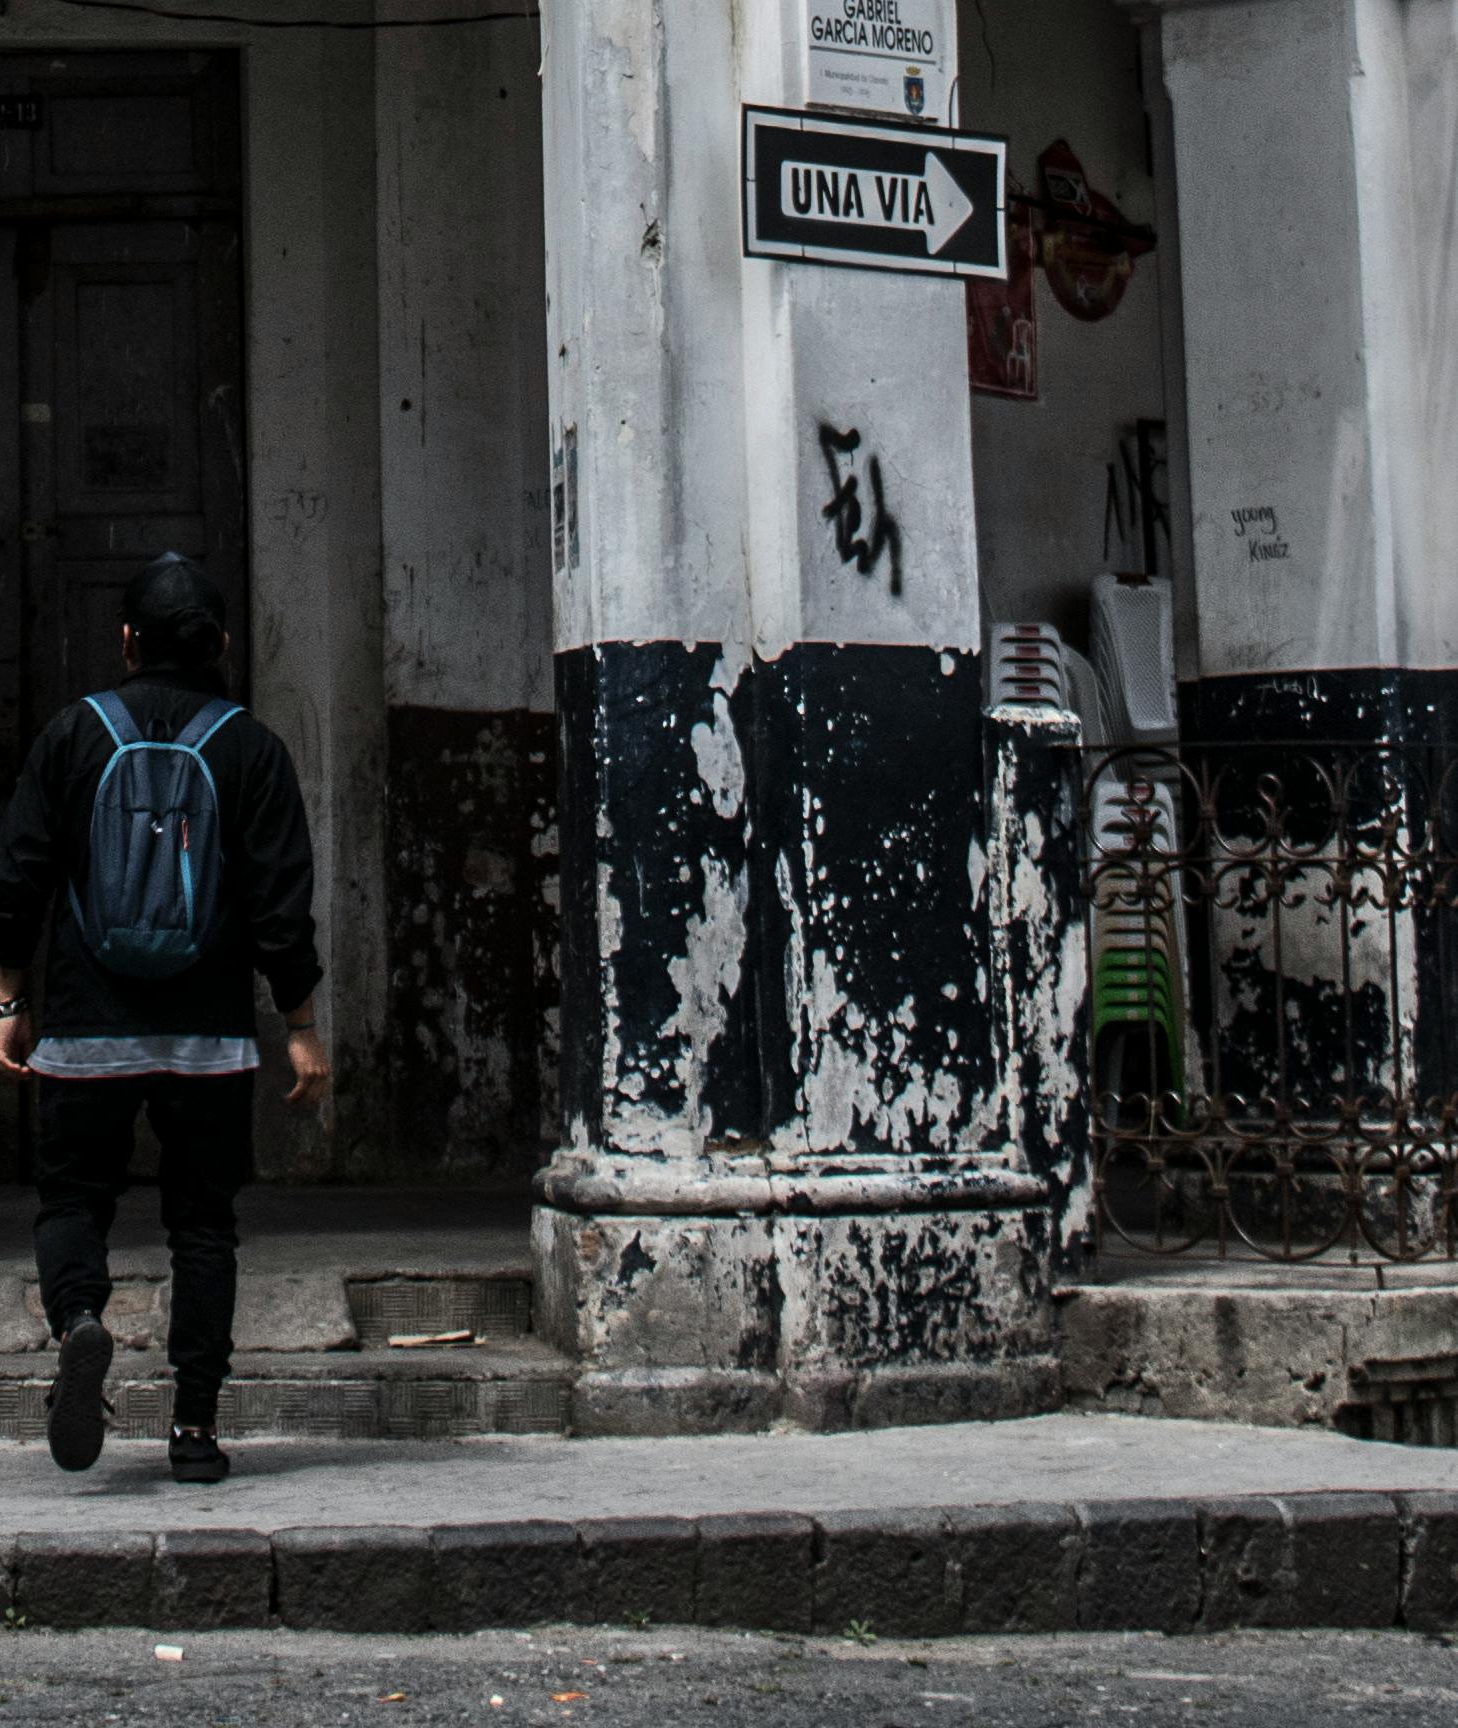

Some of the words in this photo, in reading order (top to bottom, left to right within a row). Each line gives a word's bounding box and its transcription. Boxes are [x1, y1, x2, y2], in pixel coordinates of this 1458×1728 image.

[811, 16, 869, 47] GARCIA
[872, 24, 933, 55] MORENO
[791, 167, 865, 218] UNA
[874, 175, 935, 226] VIA
